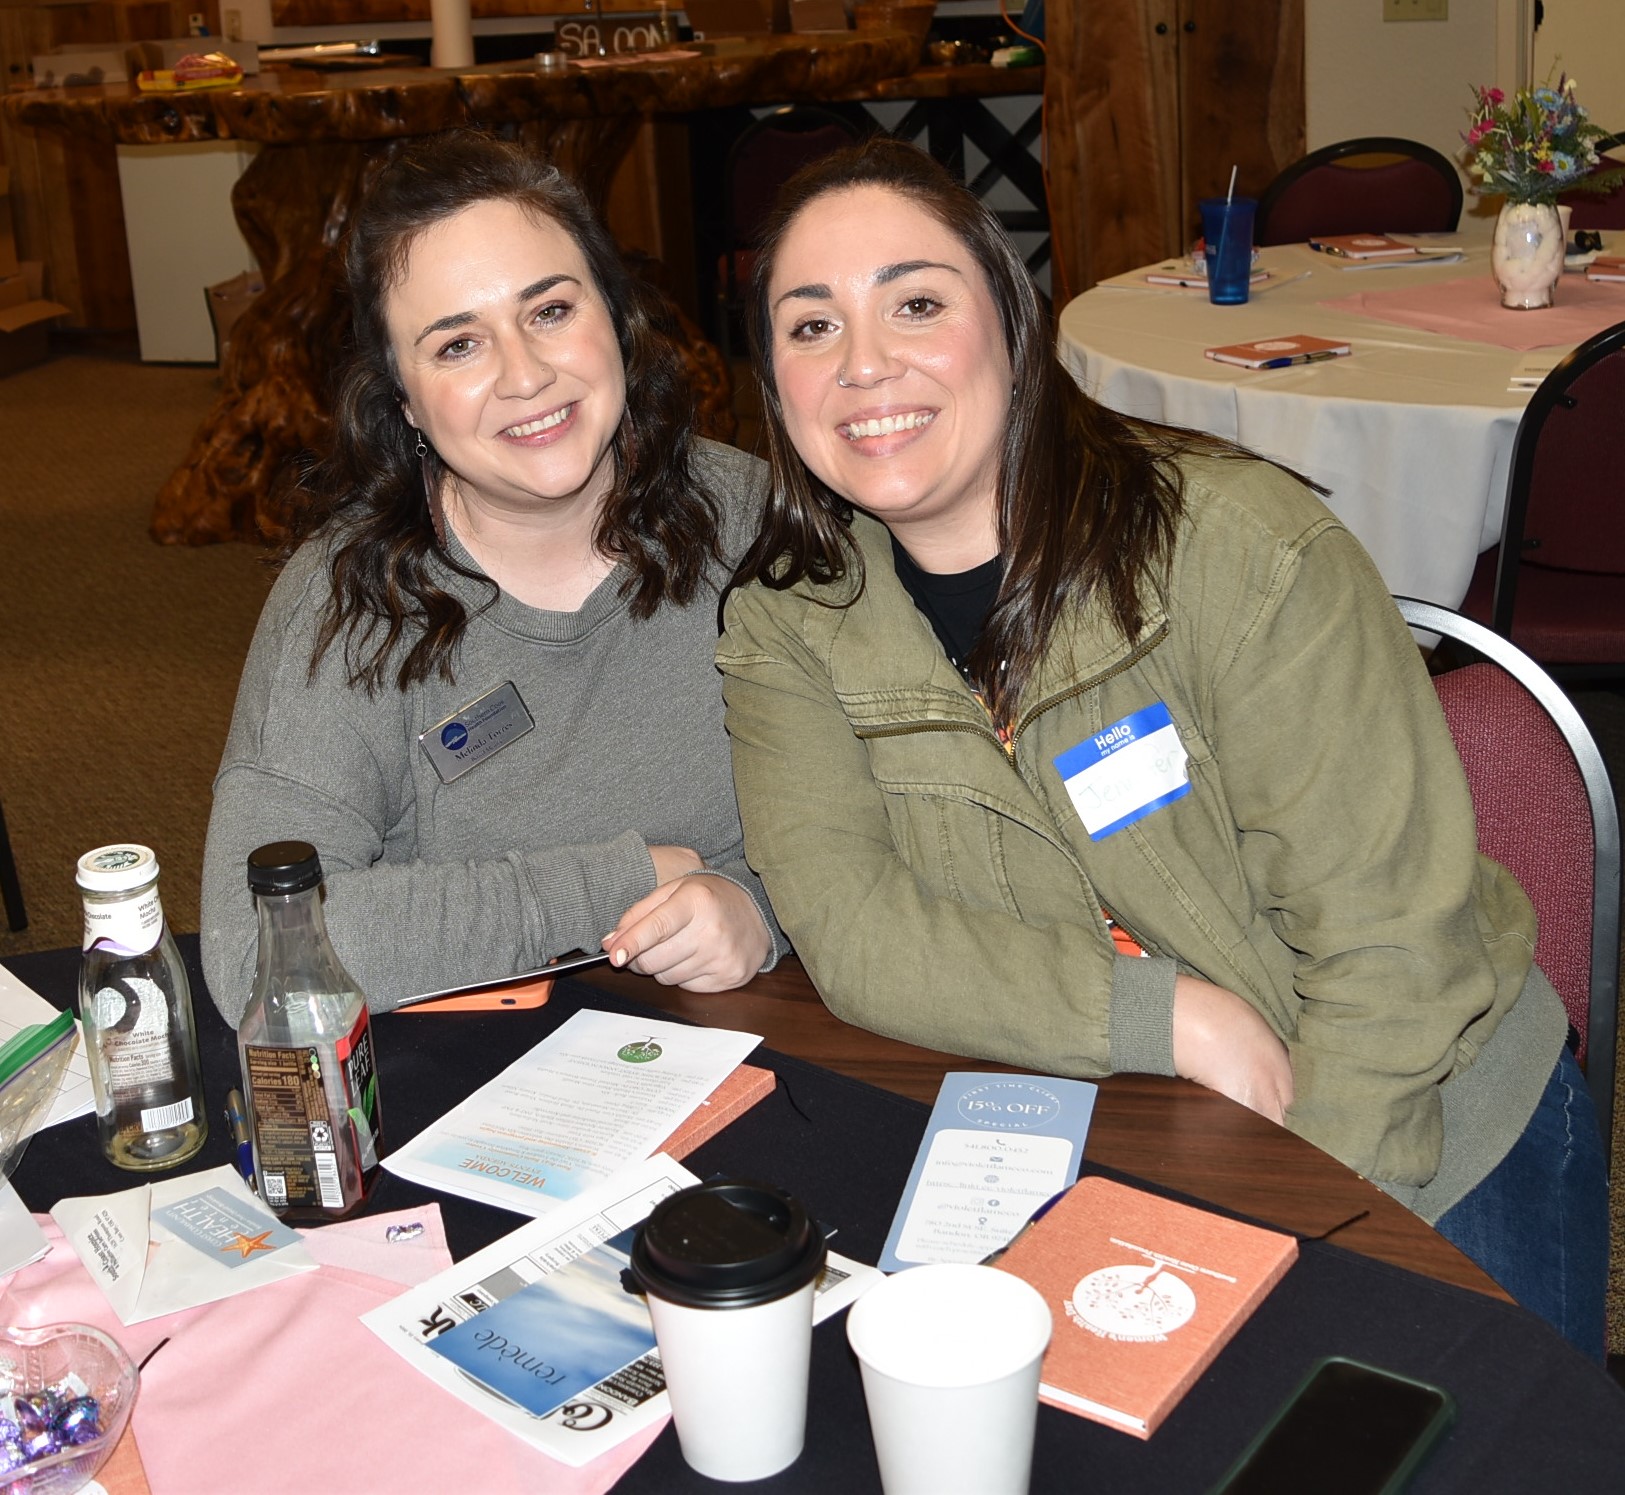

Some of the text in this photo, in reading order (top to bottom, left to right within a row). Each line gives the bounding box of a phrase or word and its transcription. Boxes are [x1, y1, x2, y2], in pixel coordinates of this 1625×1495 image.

[560, 23, 668, 56] SAOON
[455, 738, 487, 761] Melinda
[488, 722, 513, 740] Torres
[1094, 725, 1131, 750] Hello
[1100, 748, 1111, 756] my
[1111, 738, 1128, 751] name
[114, 1037, 150, 1047] Chocolate
[132, 1029, 155, 1038] White
[131, 1053, 144, 1062] Facts
[278, 1051, 296, 1059] Facts
[348, 1033, 369, 1077] PURE
[252, 1075, 282, 1085] Calories
[282, 1075, 300, 1086] 180
[967, 1100, 1050, 1115] 15% OFF
[977, 1118, 1028, 1128] SPECIAL
[458, 1156, 546, 1188] WELCOME
[171, 1201, 241, 1243] HEALTH
[474, 1327, 569, 1387] remède
[597, 1384, 638, 1406] BANDON
